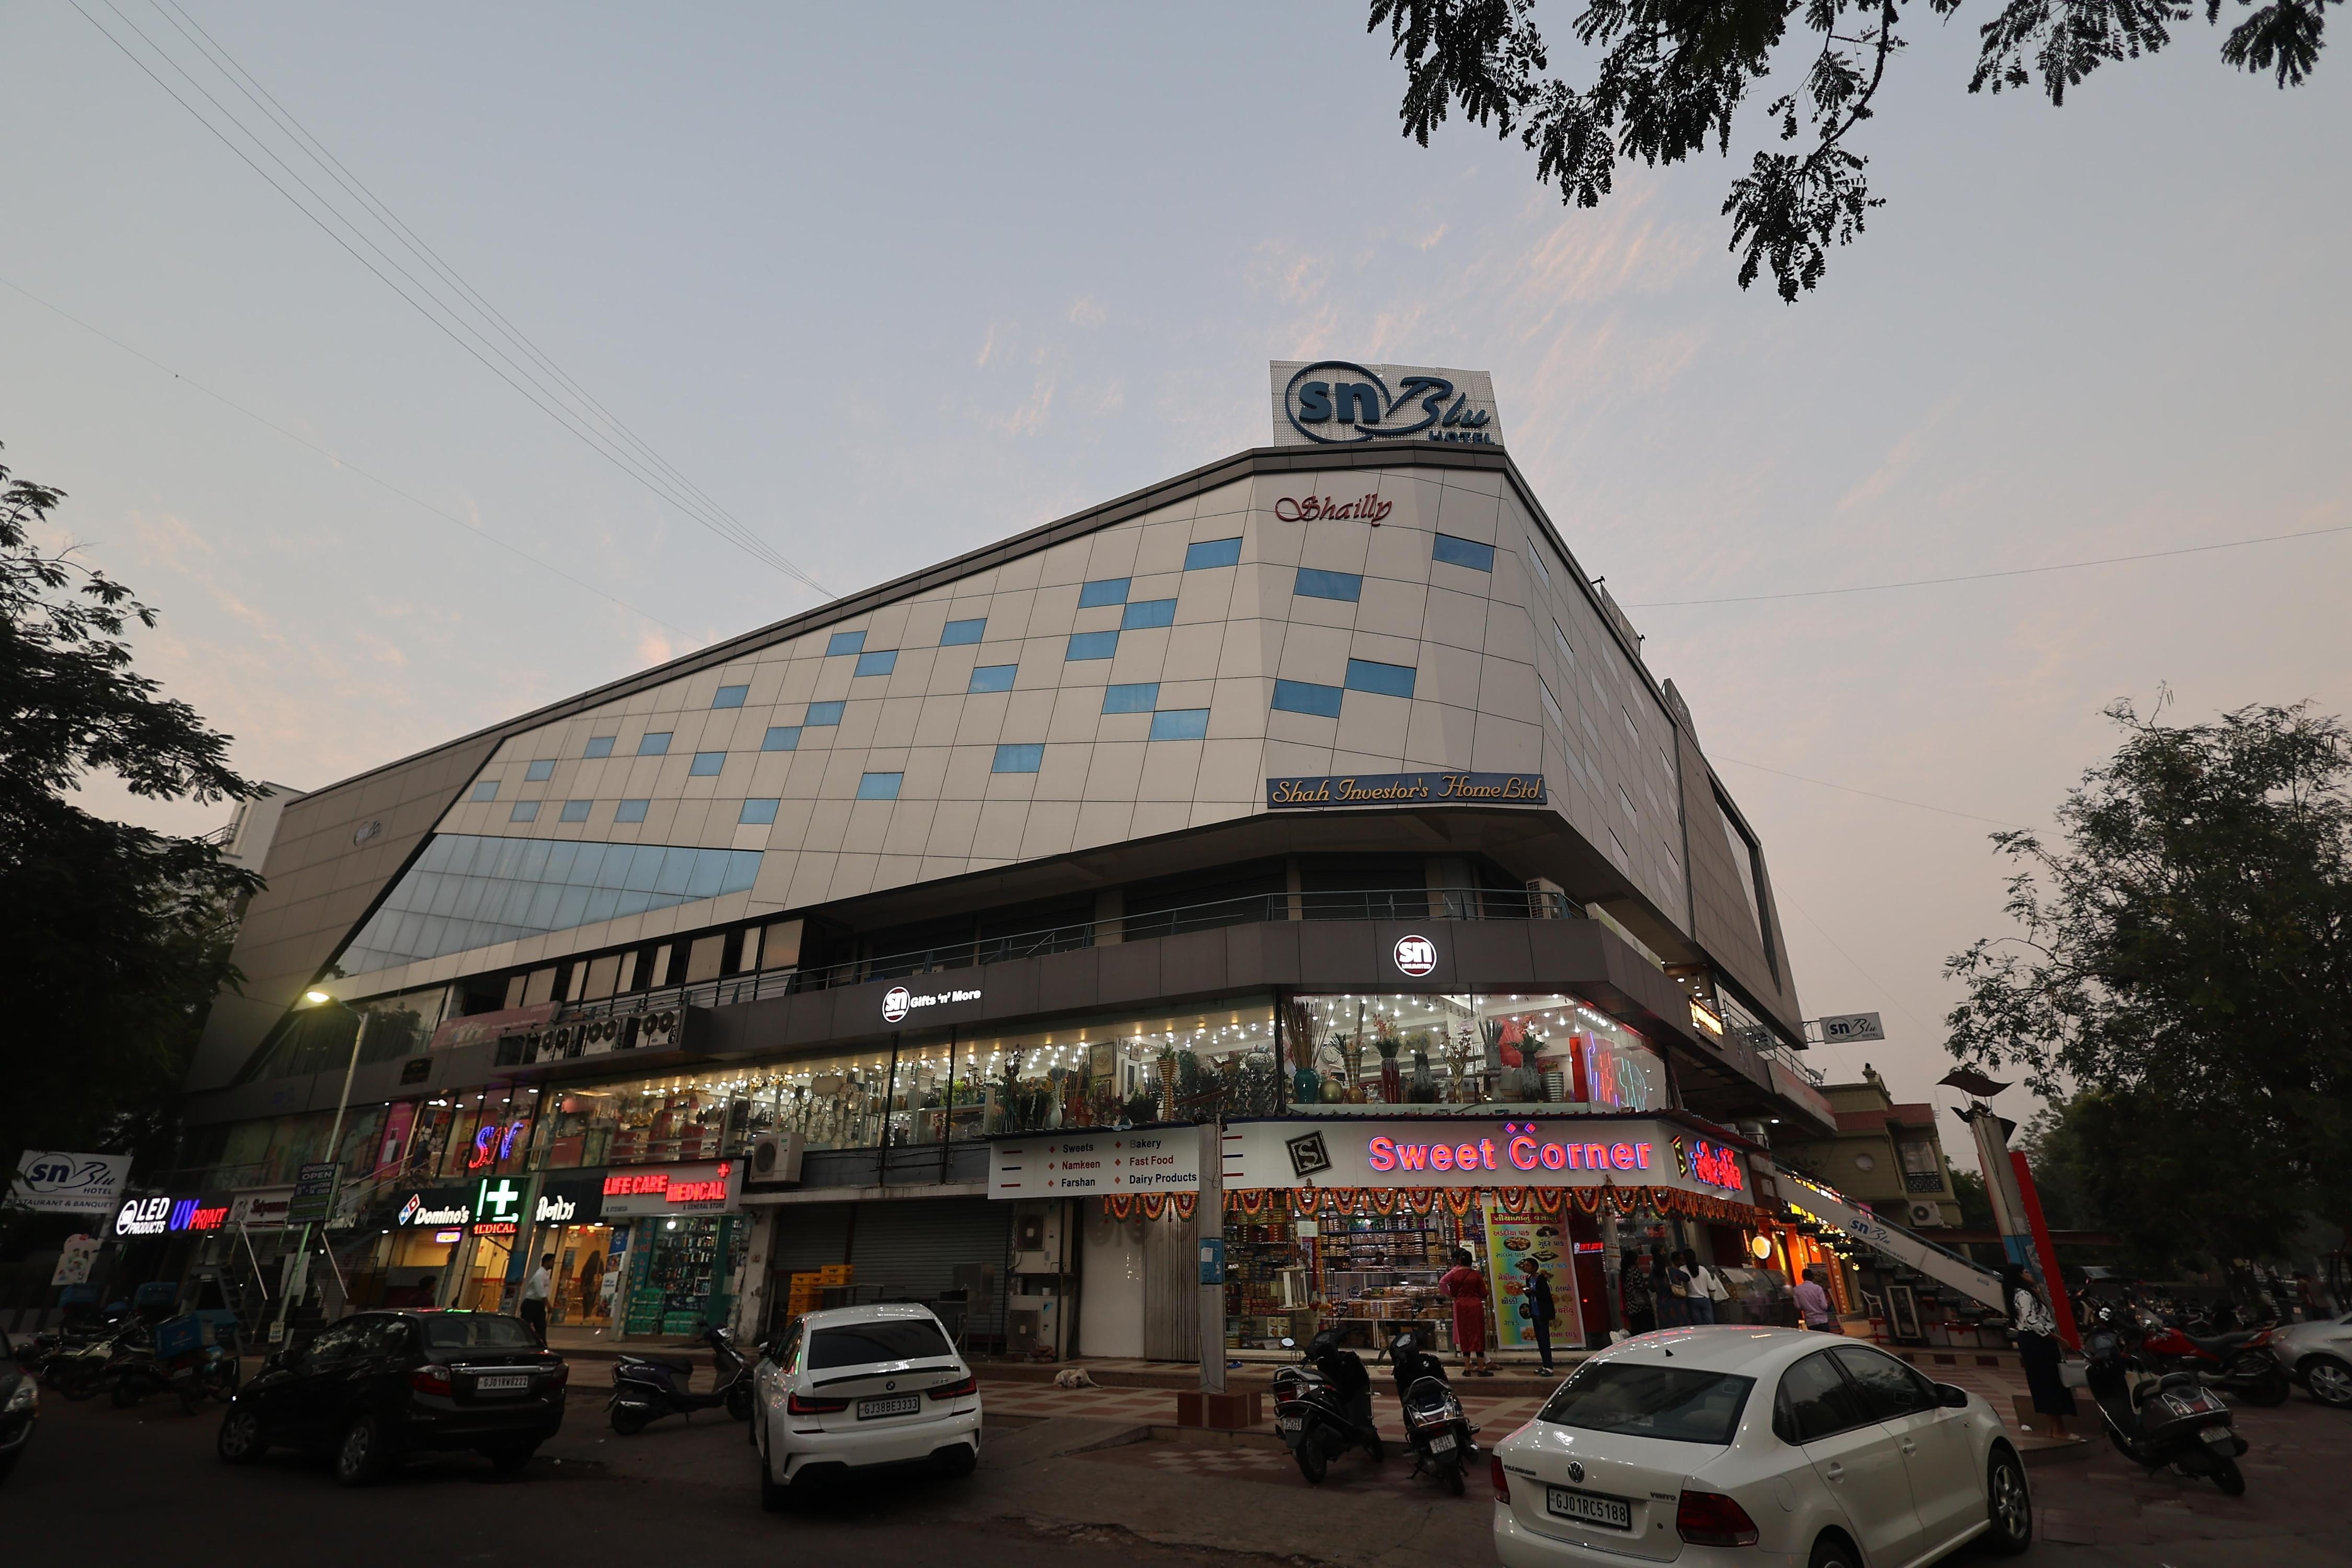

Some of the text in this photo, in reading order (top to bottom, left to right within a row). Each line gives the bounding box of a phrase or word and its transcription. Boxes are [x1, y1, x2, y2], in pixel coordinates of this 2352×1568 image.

[1354, 376, 1491, 436] Blu
[1428, 430, 1496, 445] HOTEL
[1275, 493, 1393, 527] Shailly
[1272, 781, 1330, 803] Shah
[1334, 777, 1429, 800] Investor's
[1438, 775, 1501, 799] Home
[910, 995, 936, 1008] Gifts
[952, 989, 982, 1002] More
[1846, 1018, 1876, 1037] Blu
[1063, 1143, 1094, 1153] Sweets
[1130, 1138, 1161, 1149] Bakery
[1369, 1136, 1497, 1171] Sweet
[1508, 1134, 1653, 1171] Corner
[1062, 1160, 1100, 1170] Namkeen
[1129, 1155, 1174, 1166] Fast Food
[54, 1161, 116, 1189] Blu
[302, 1171, 332, 1180] OPEN
[1061, 1178, 1096, 1187] Farshan
[1129, 1172, 1197, 1185] Dairy Products
[603, 1175, 726, 1202] LIFE CARE MEDICAL
[136, 1197, 171, 1221] LED
[169, 1198, 201, 1231] UV
[188, 1207, 229, 1230] PRINT
[413, 1205, 470, 1225] Domino's
[128, 1220, 167, 1235] PRODUCTS
[864, 1399, 917, 1414] GJ38BE3333
[1556, 1493, 1626, 1522] GJ01RC5188
